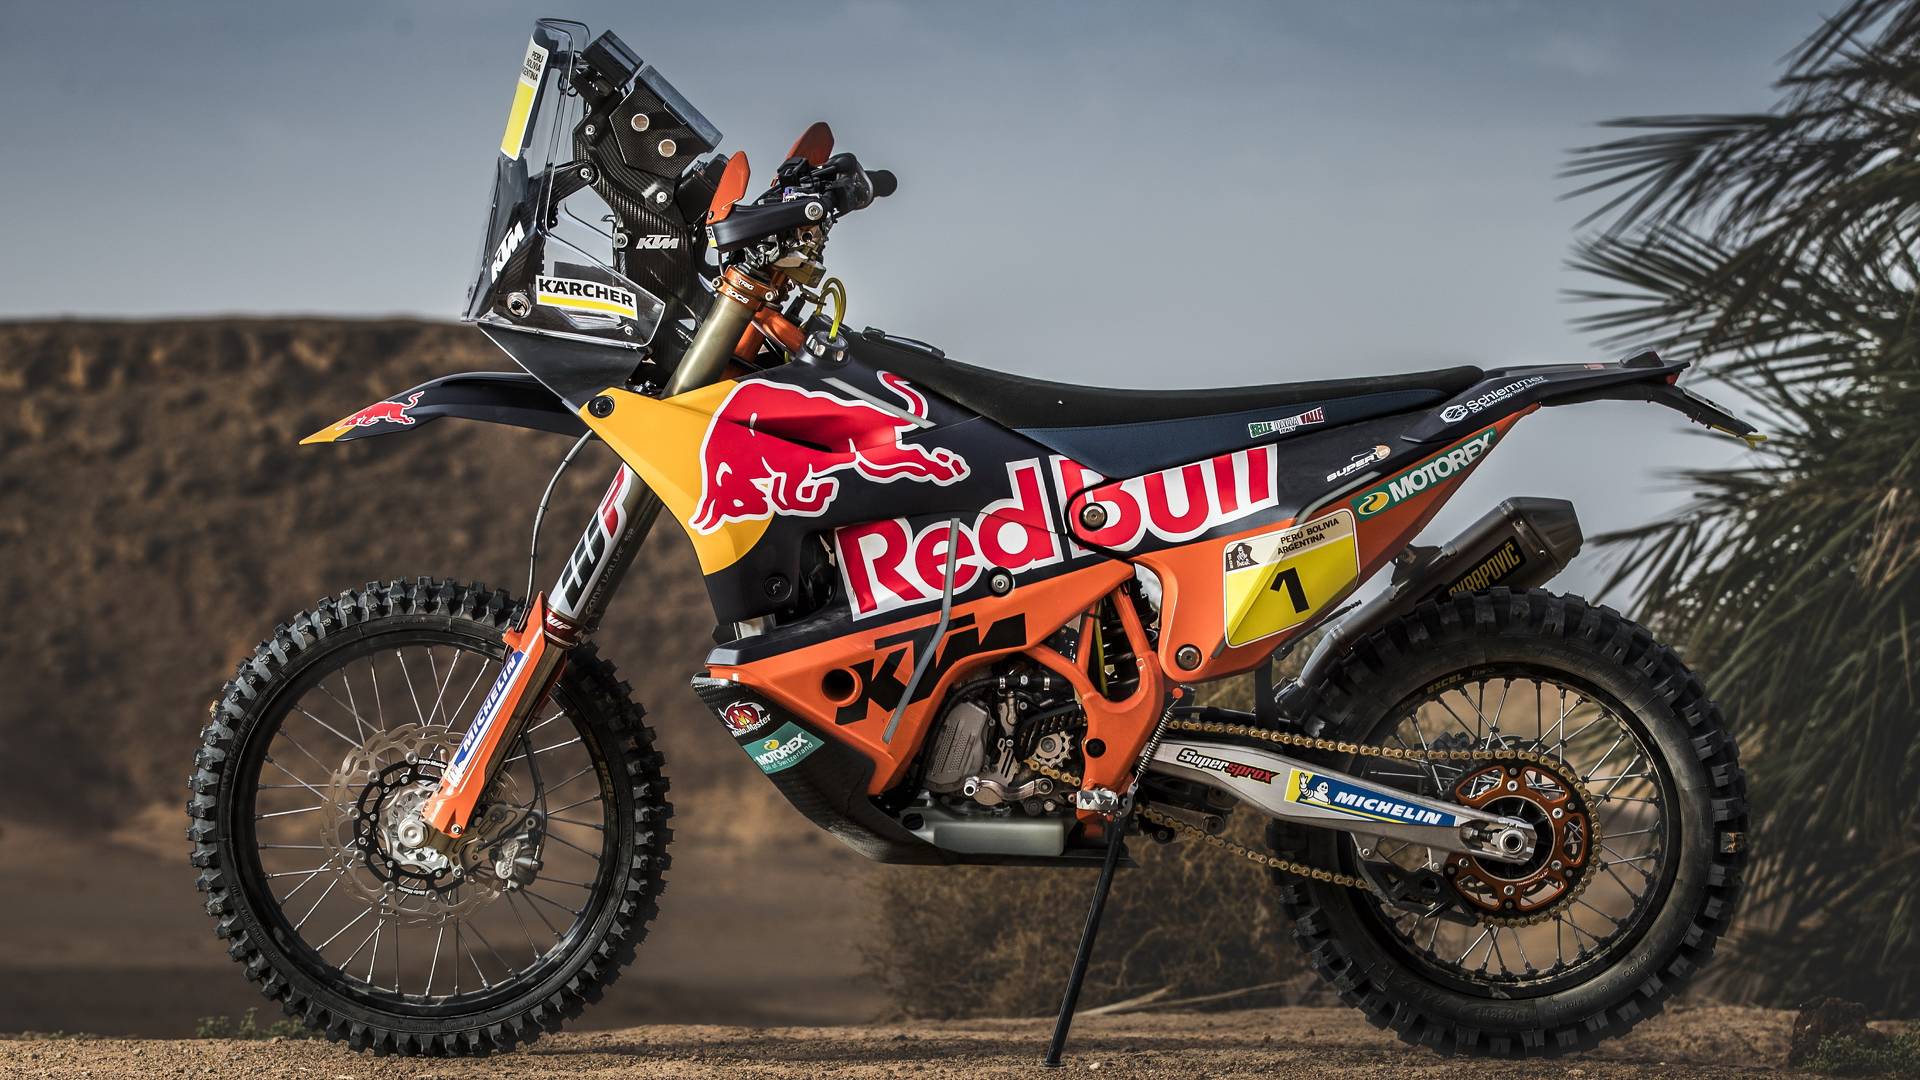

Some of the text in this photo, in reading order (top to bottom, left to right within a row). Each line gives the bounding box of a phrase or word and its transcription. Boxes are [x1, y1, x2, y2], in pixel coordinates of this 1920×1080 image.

[491, 221, 525, 284] KTM
[636, 234, 679, 249] KTM
[538, 278, 634, 308] KÄRCHER
[1467, 375, 1545, 409] Schlemmer
[1388, 432, 1490, 502] MOTOREX
[834, 443, 1279, 622] Red Bull
[1277, 533, 1326, 555] ARGENTINA
[1306, 518, 1340, 535] BOLIVIA
[1270, 567, 1310, 614] 1
[834, 612, 1027, 726] KTM
[462, 655, 517, 753] MICHELIN
[755, 732, 808, 766] MOTOREX
[1177, 748, 1279, 784] Supersprox
[1334, 791, 1442, 825] MICHELIN
